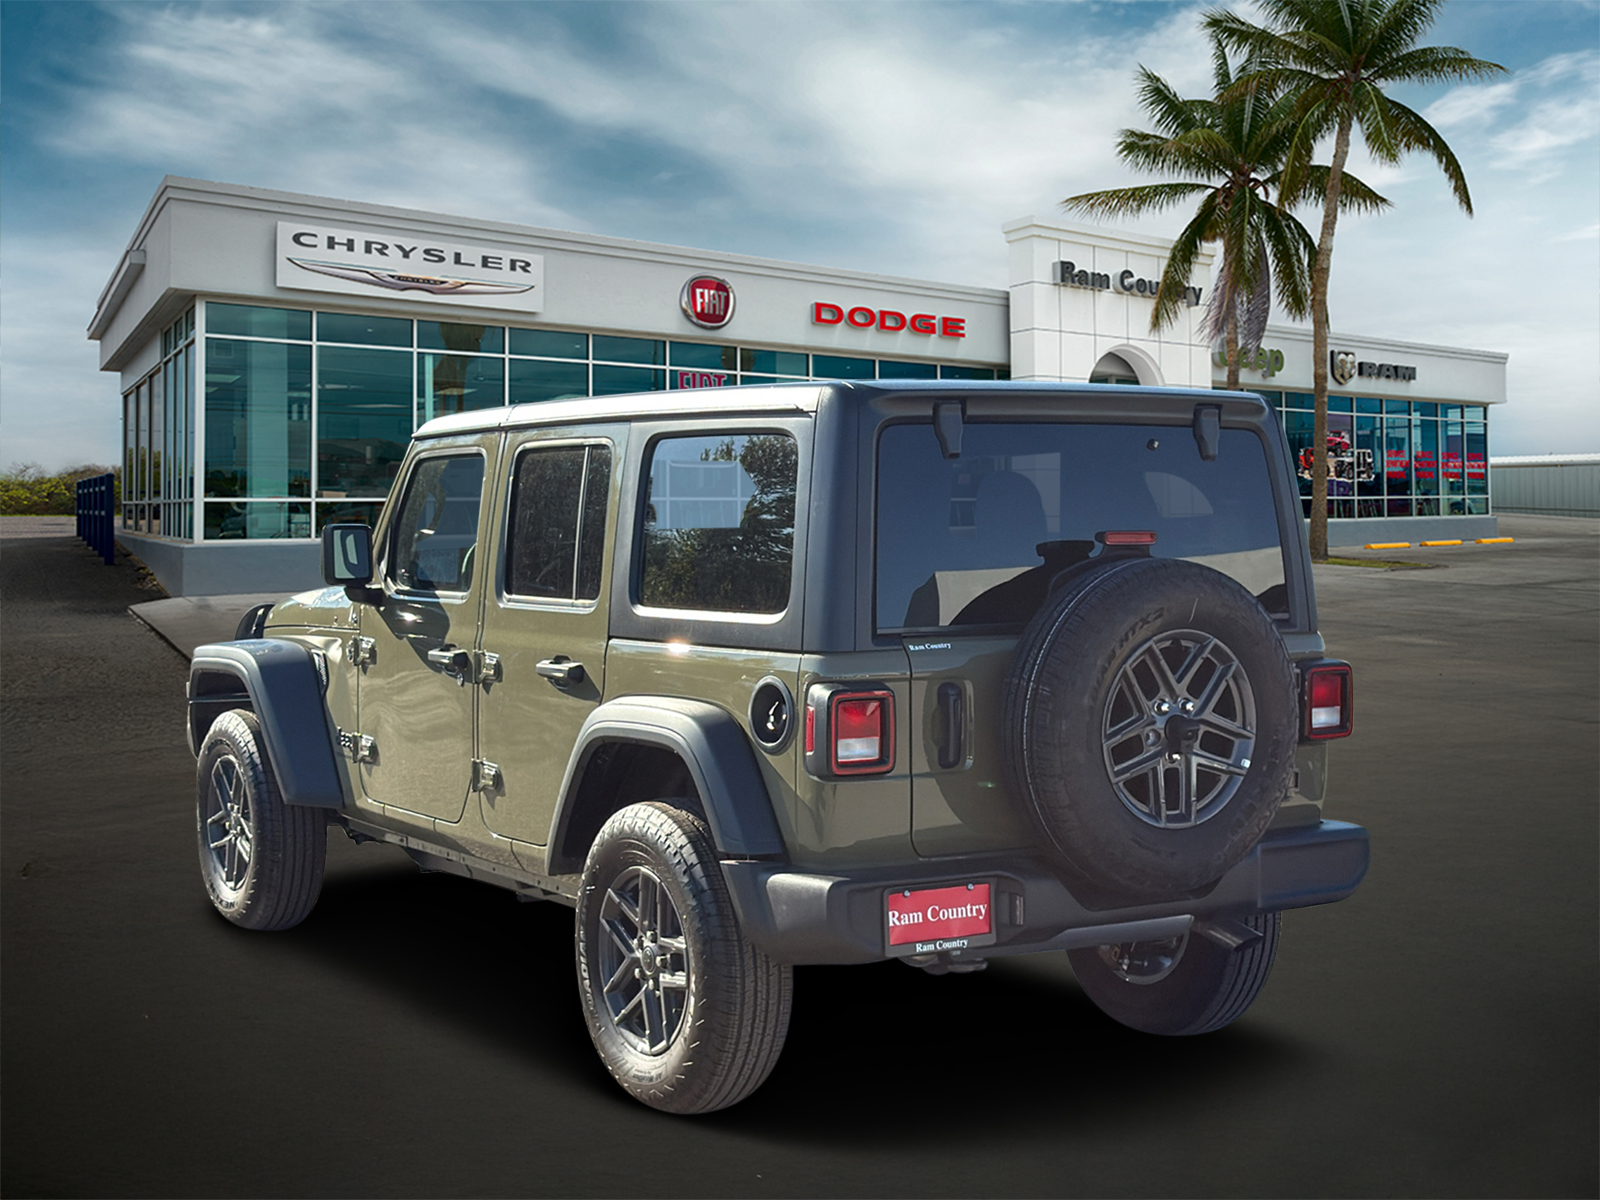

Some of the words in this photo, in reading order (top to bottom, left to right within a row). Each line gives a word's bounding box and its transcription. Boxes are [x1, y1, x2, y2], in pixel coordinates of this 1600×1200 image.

[292, 231, 532, 274] CHRYSLER
[1053, 260, 1111, 291] Ram
[1115, 269, 1203, 307] Coury
[695, 287, 728, 317] FIAT
[812, 301, 966, 338] DODGE
[1358, 361, 1417, 381] RAM
[888, 910, 923, 927] Ram
[927, 903, 988, 922] Country
[915, 943, 935, 952] Ram
[936, 938, 969, 950] Country
